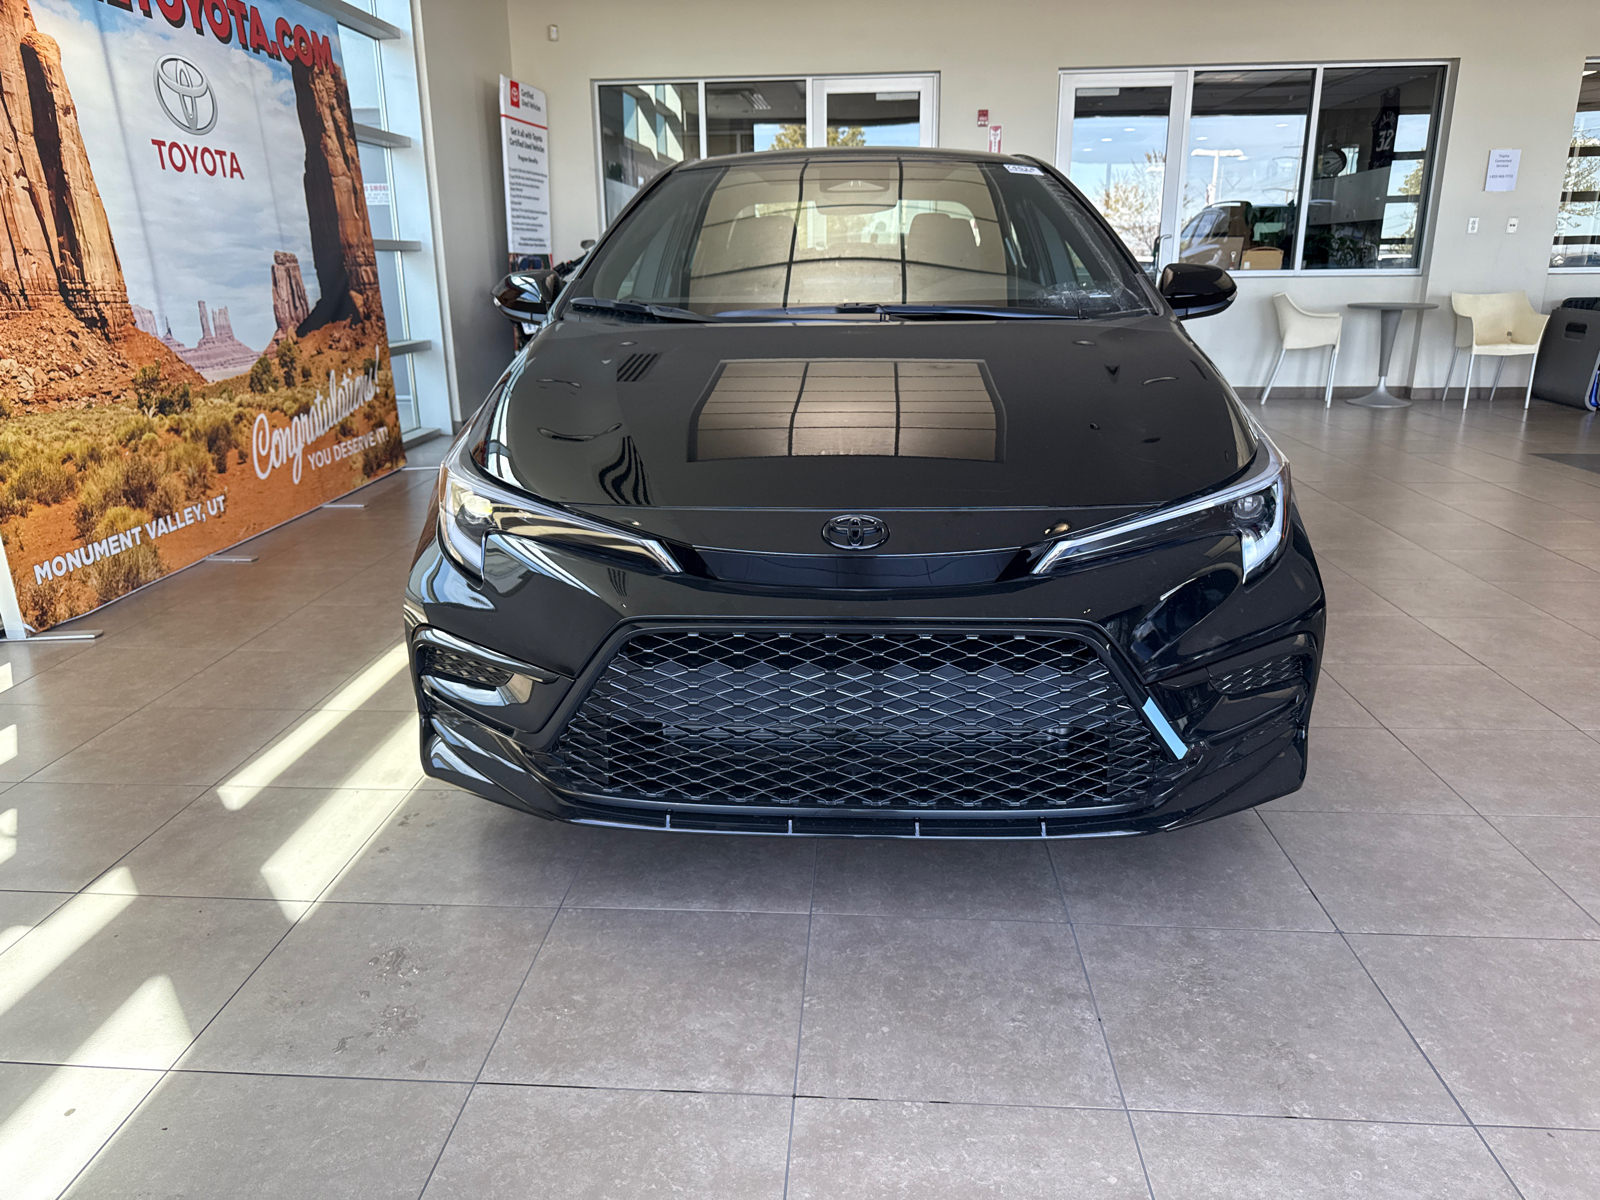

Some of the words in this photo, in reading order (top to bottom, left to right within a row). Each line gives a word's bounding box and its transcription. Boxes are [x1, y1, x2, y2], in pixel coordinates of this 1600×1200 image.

[151, 138, 245, 181] TOYOTA
[1375, 129, 1394, 152] 32
[252, 344, 380, 485] Congratulations!
[307, 447, 332, 470] YOU
[333, 433, 376, 461] DESERVE
[376, 426, 390, 444] IT!
[33, 526, 142, 585] MONUMENT
[145, 503, 207, 540] VALLEY,
[206, 495, 226, 516] UT
